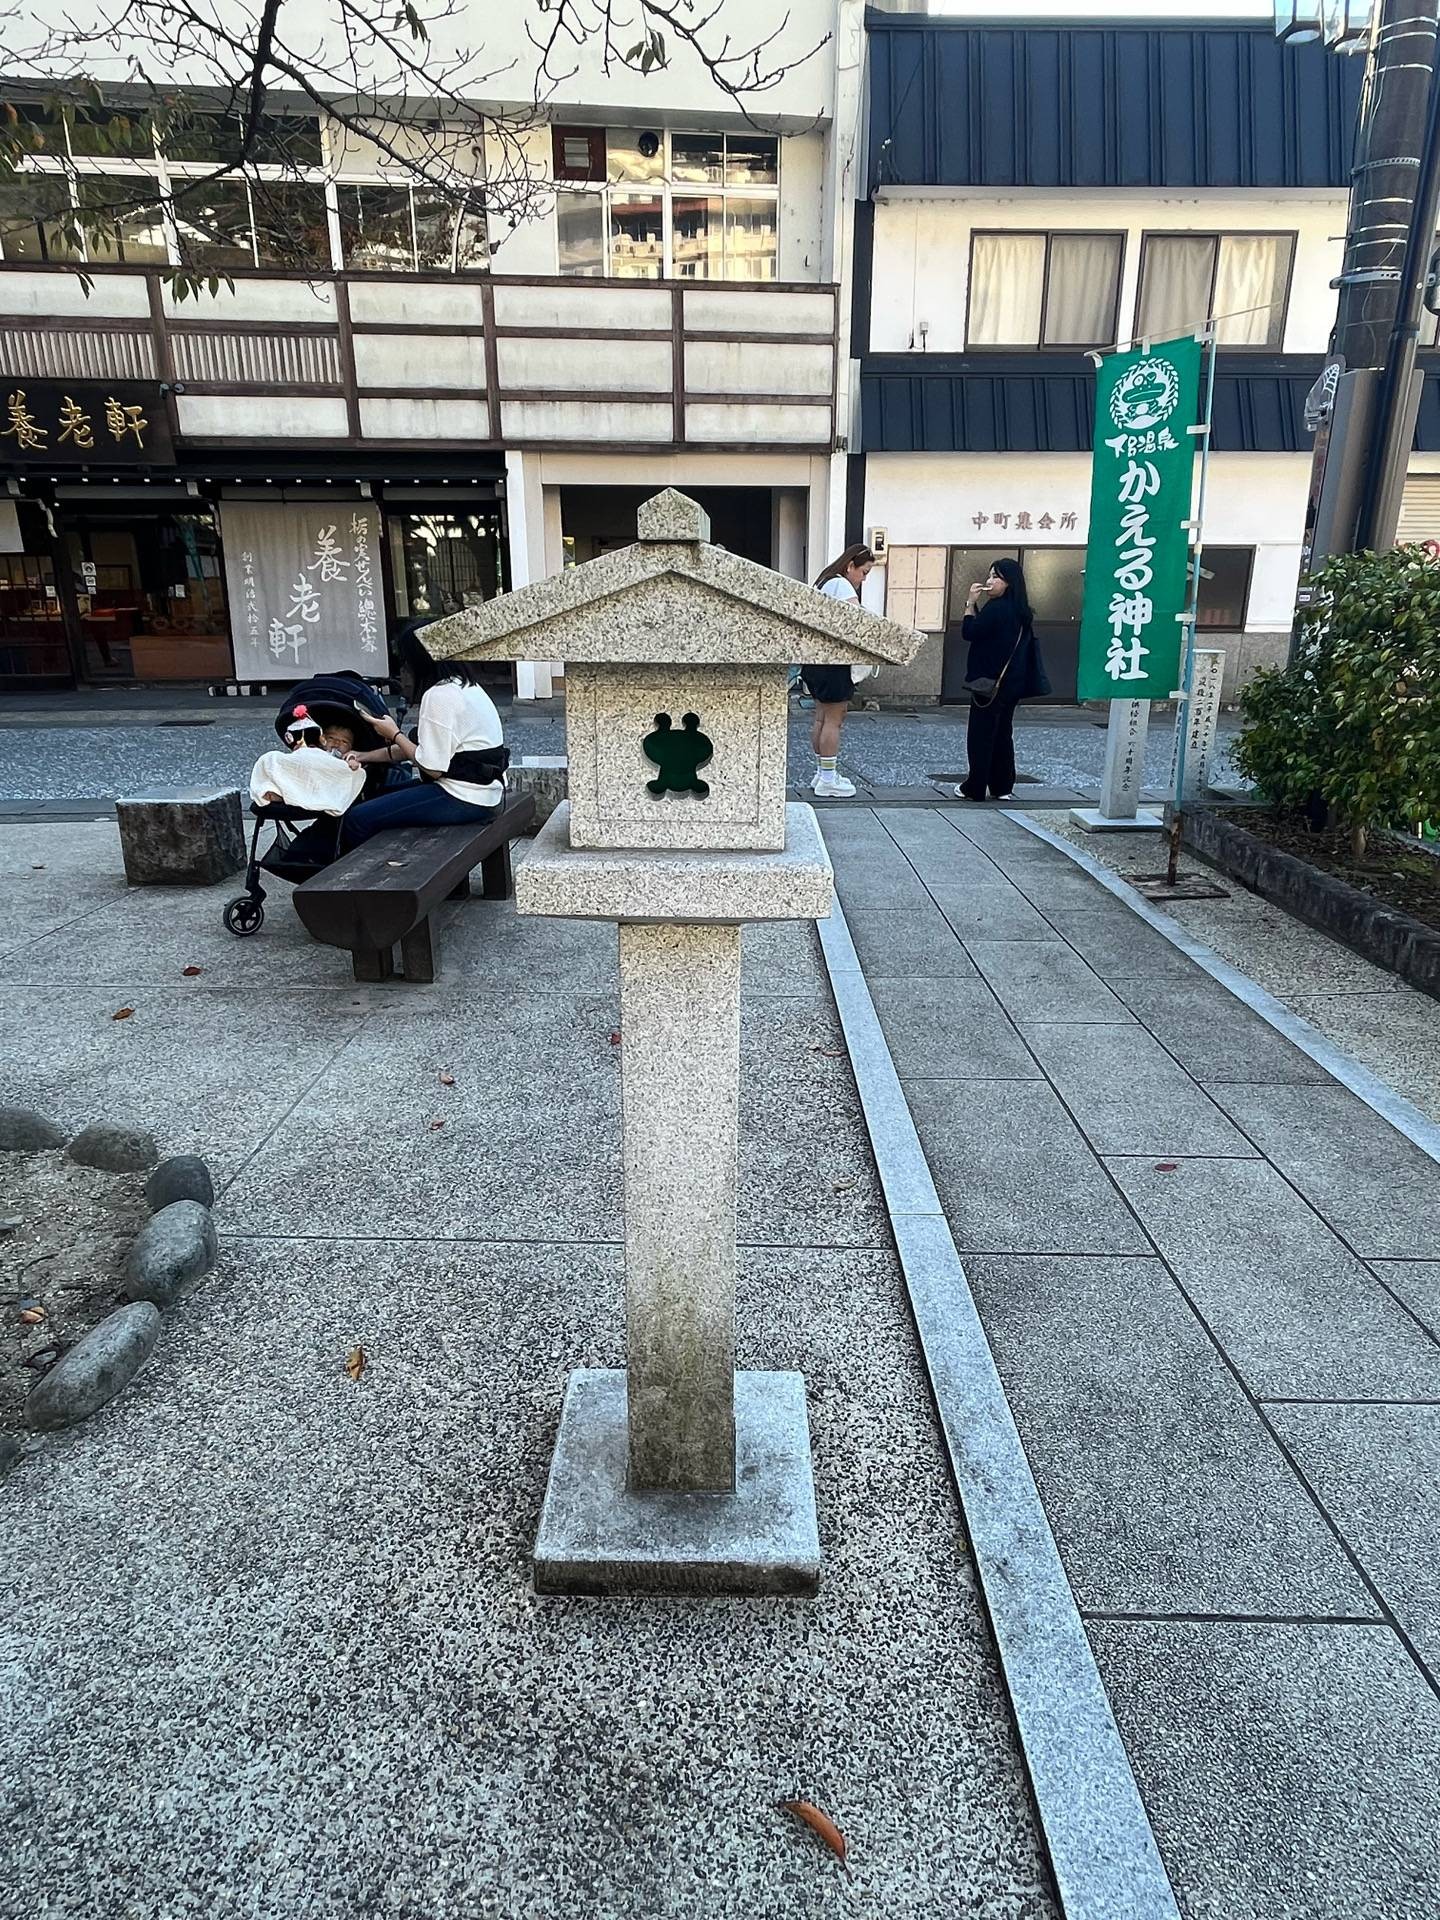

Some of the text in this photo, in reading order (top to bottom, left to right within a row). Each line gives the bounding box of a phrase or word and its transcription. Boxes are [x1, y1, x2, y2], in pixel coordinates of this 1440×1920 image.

[1, 389, 148, 450] 養老軒
[1105, 426, 1179, 458] 下呂温泉
[972, 511, 1079, 531] 中町集会所
[271, 525, 350, 664] 養老軒
[1104, 460, 1161, 681] かえる神社
